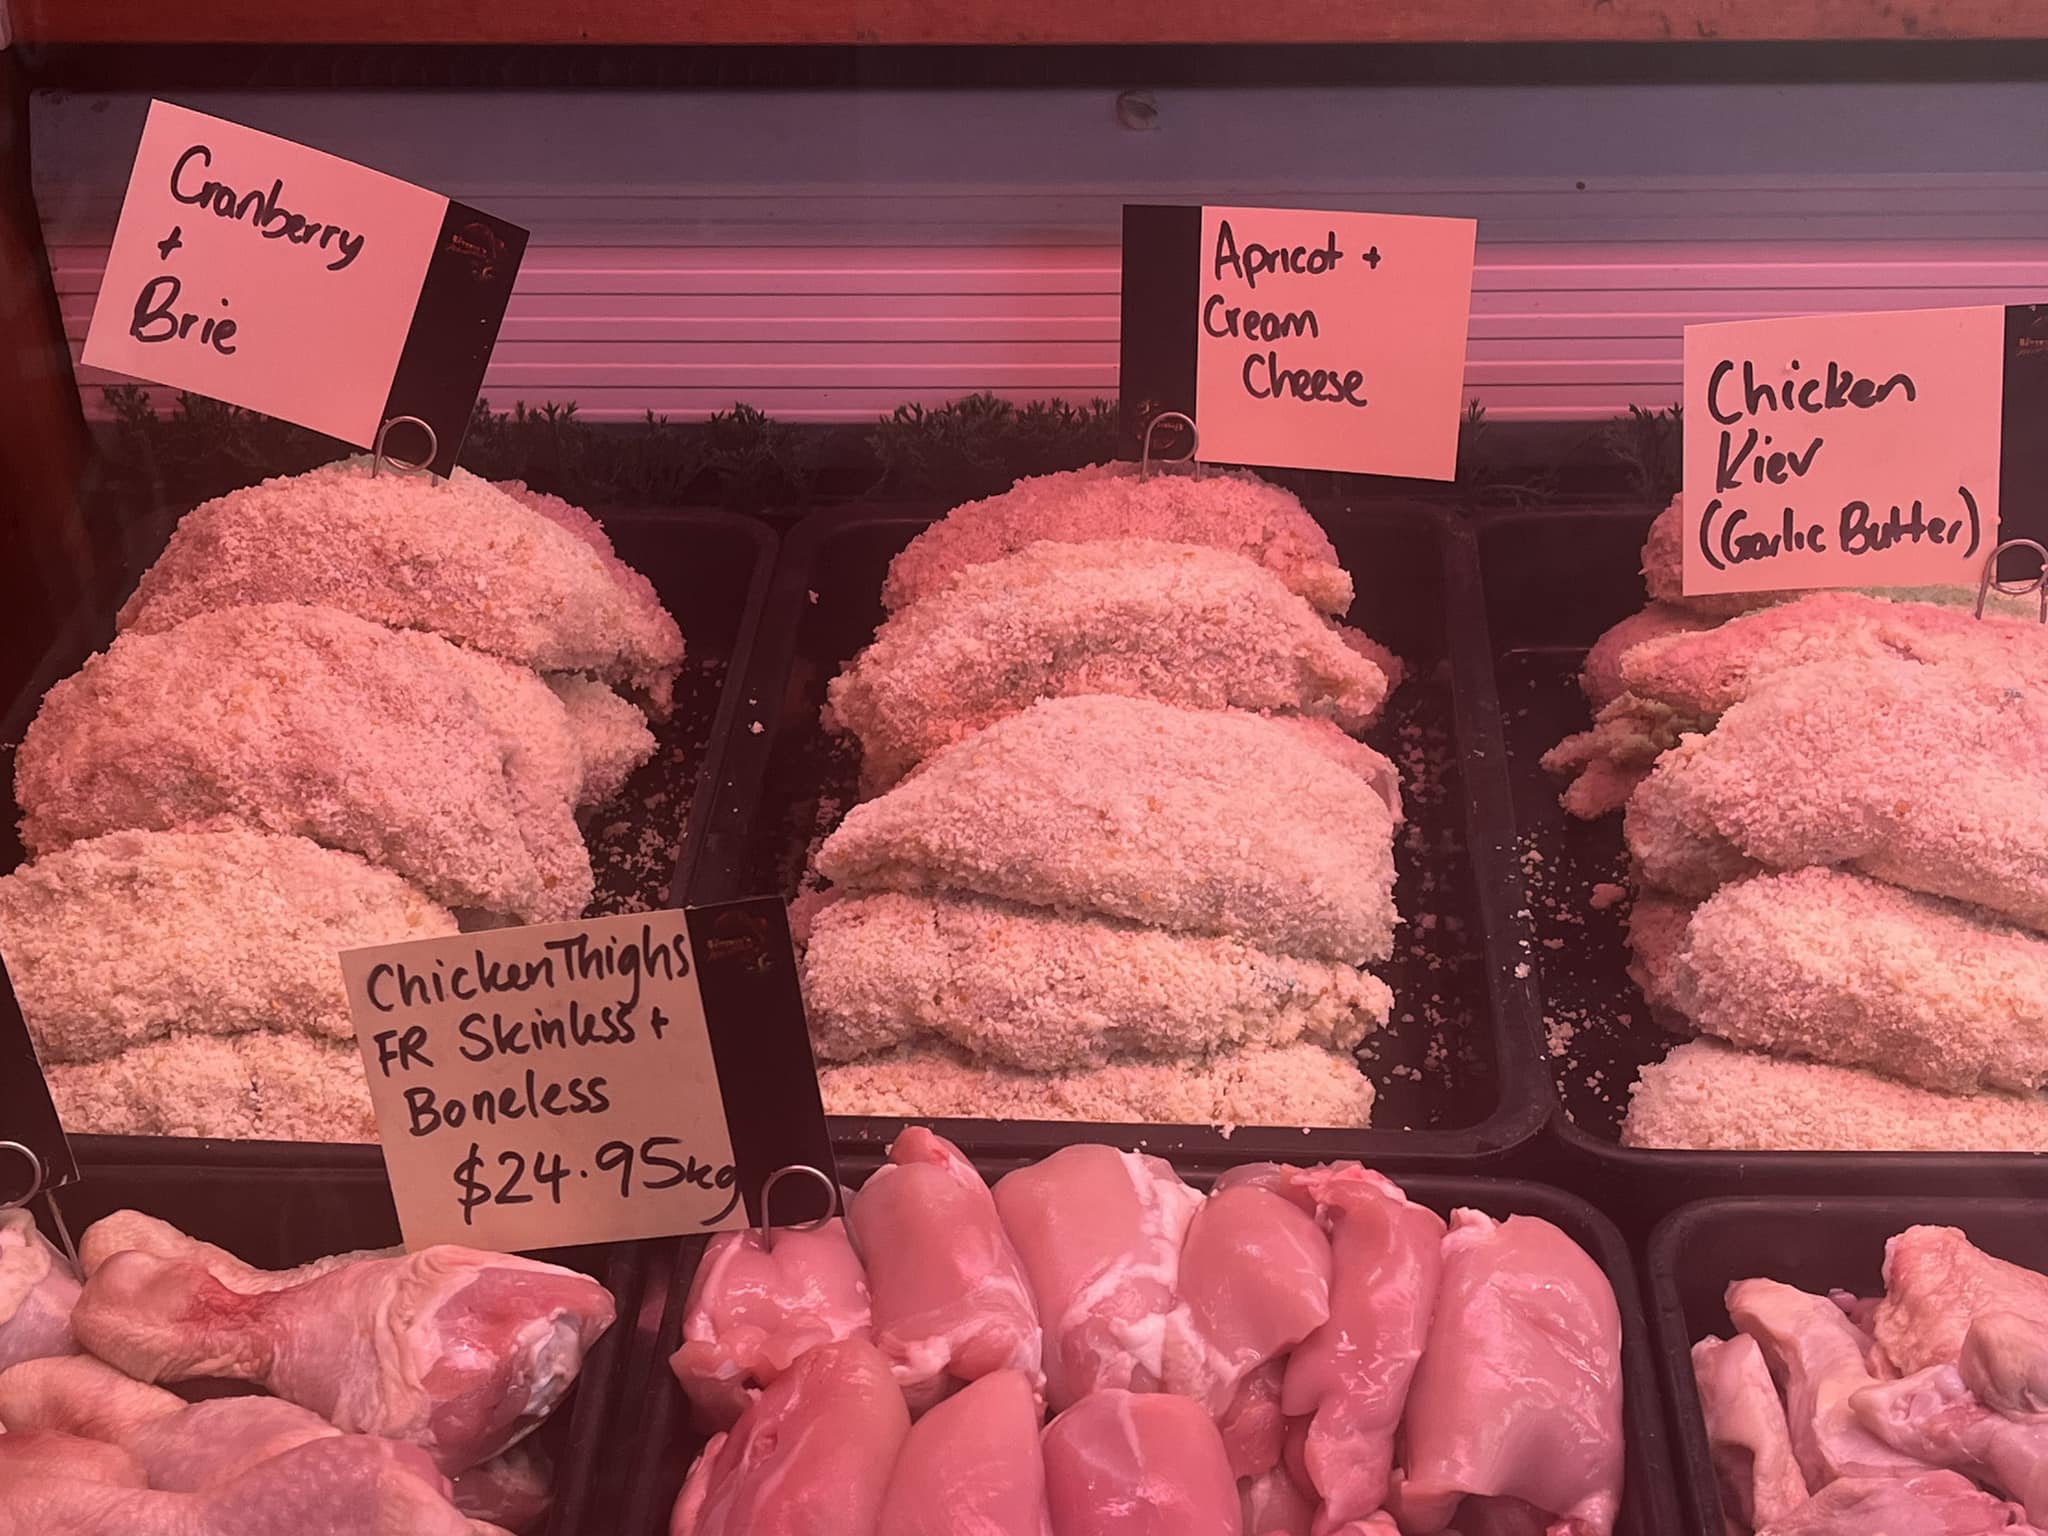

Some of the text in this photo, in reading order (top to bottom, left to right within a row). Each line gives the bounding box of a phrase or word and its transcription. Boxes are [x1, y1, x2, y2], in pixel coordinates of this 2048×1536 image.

[157, 226, 183, 260] +
[170, 145, 365, 271] Cranberry
[1214, 219, 1382, 289] Apricot +
[129, 275, 237, 355] Brie
[1203, 294, 1319, 342] Cream
[1242, 350, 1368, 408] Cheese
[1707, 359, 1917, 425] Chicken
[1715, 428, 1824, 494] Kiev
[1699, 485, 1981, 571] (Garlic Butter)
[372, 1024, 434, 1077] FR
[458, 1000, 636, 1063] Skinless
[402, 1068, 611, 1138] Boneless
